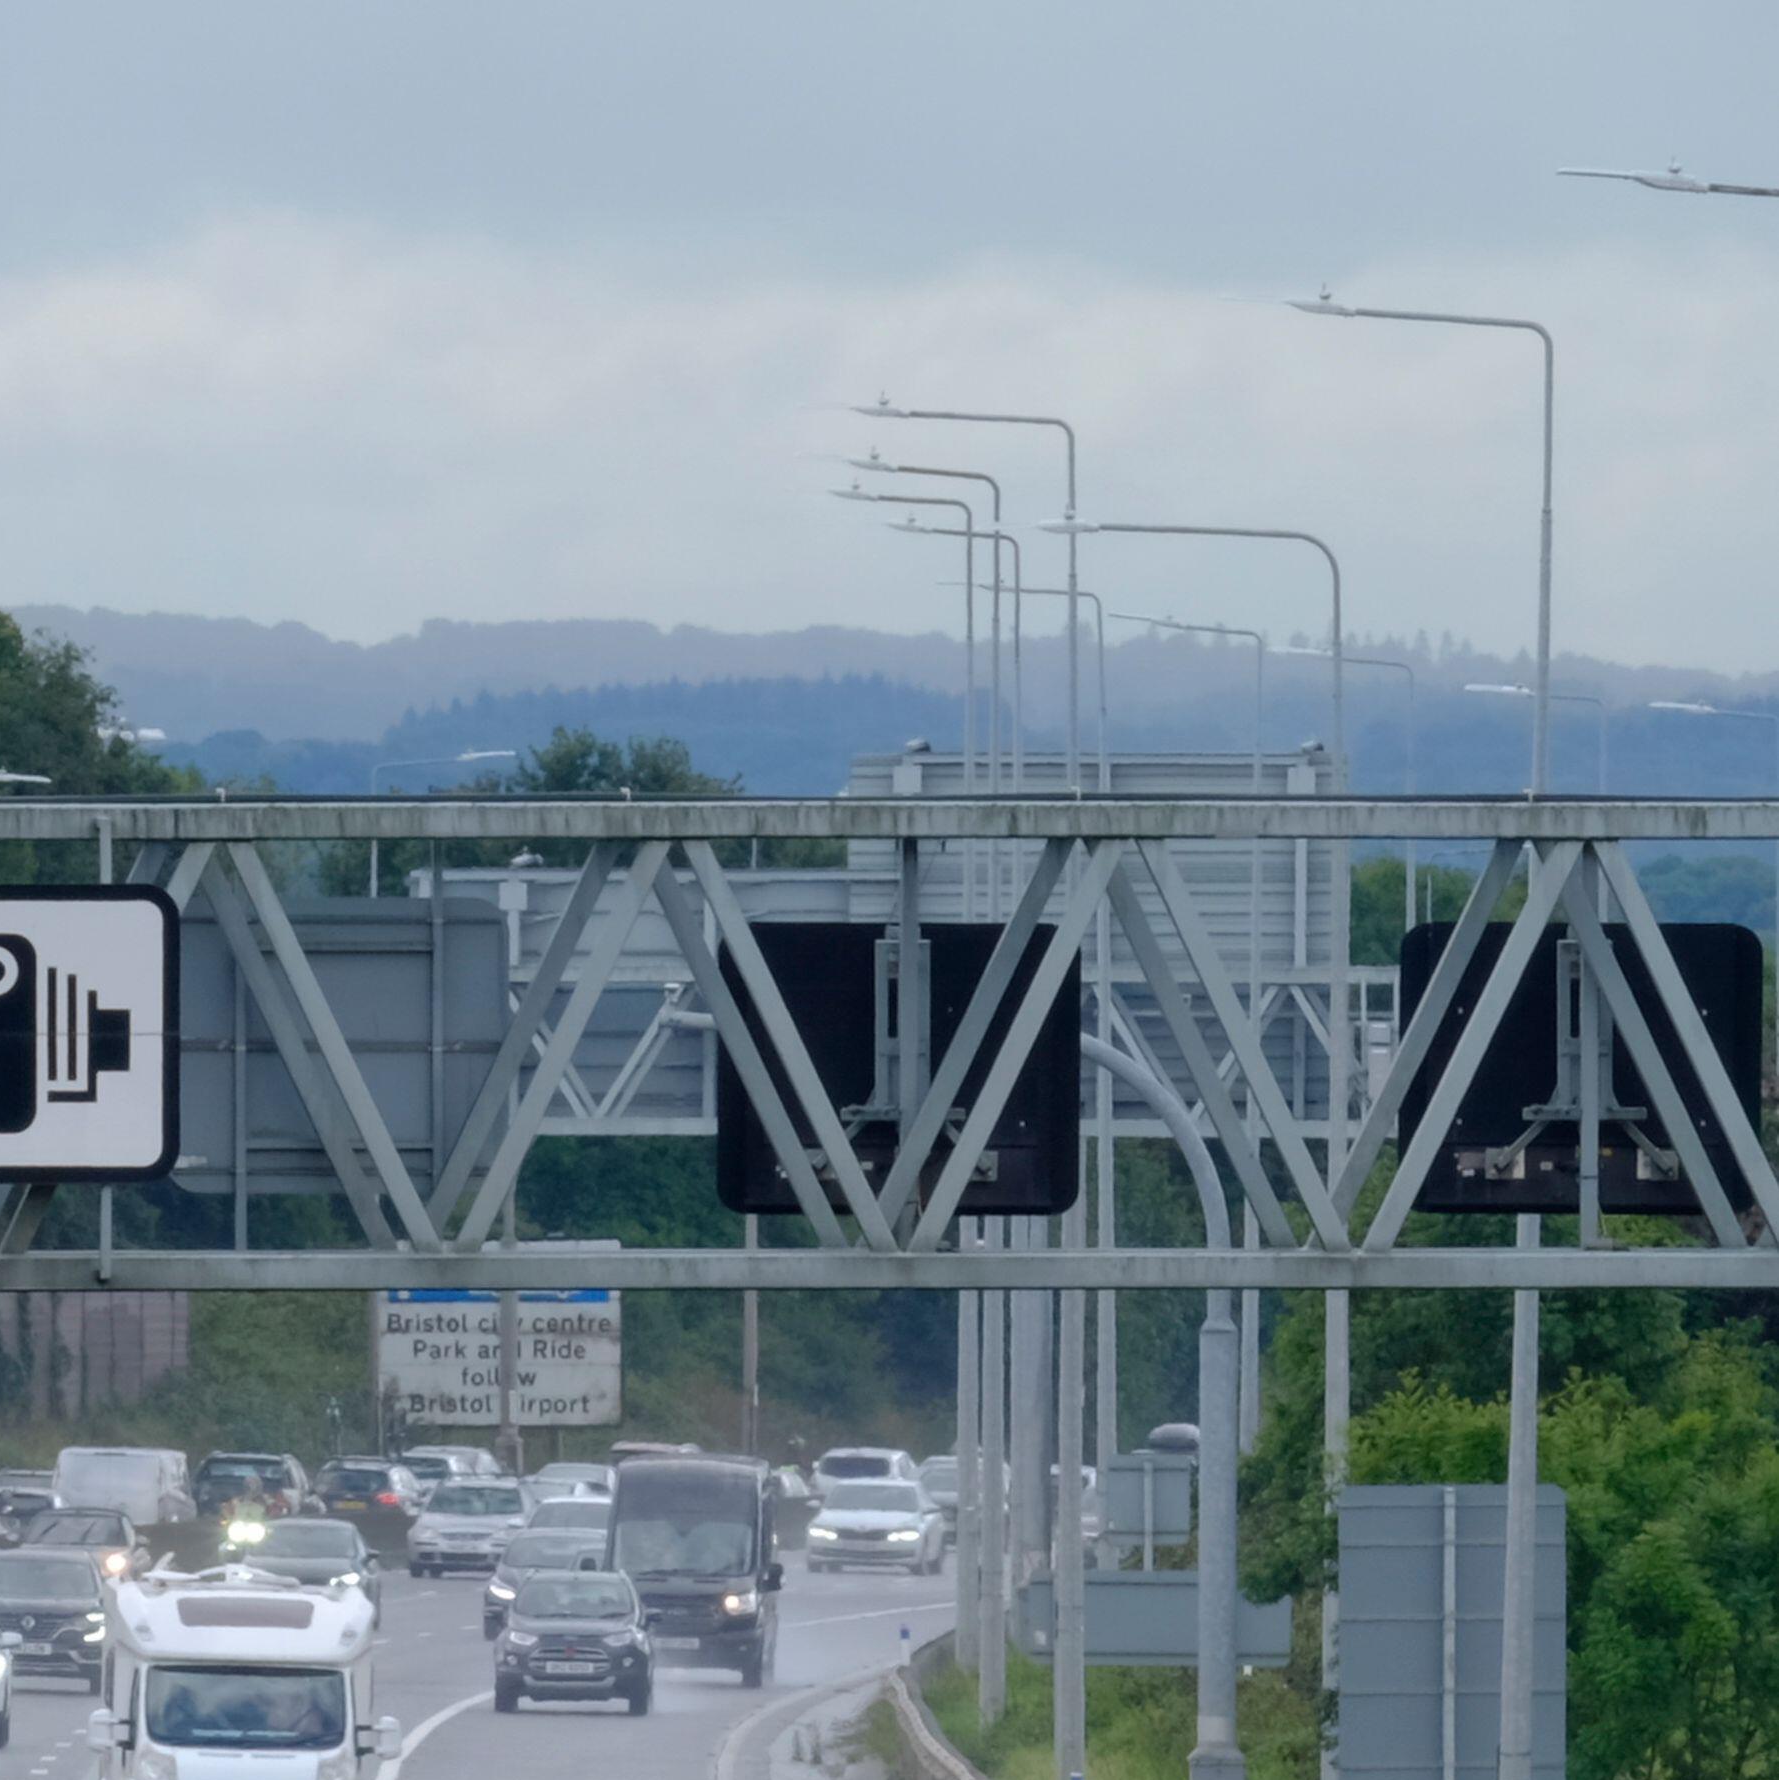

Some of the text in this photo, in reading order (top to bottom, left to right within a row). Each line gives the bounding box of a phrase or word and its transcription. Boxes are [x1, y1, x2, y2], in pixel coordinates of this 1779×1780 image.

[387, 1312, 468, 1334] Bristol
[531, 1314, 611, 1334] centre
[412, 1339, 467, 1360] Park
[532, 1339, 587, 1360] Ride
[461, 1367, 537, 1387] follw
[408, 1393, 591, 1417] Bristol irport
